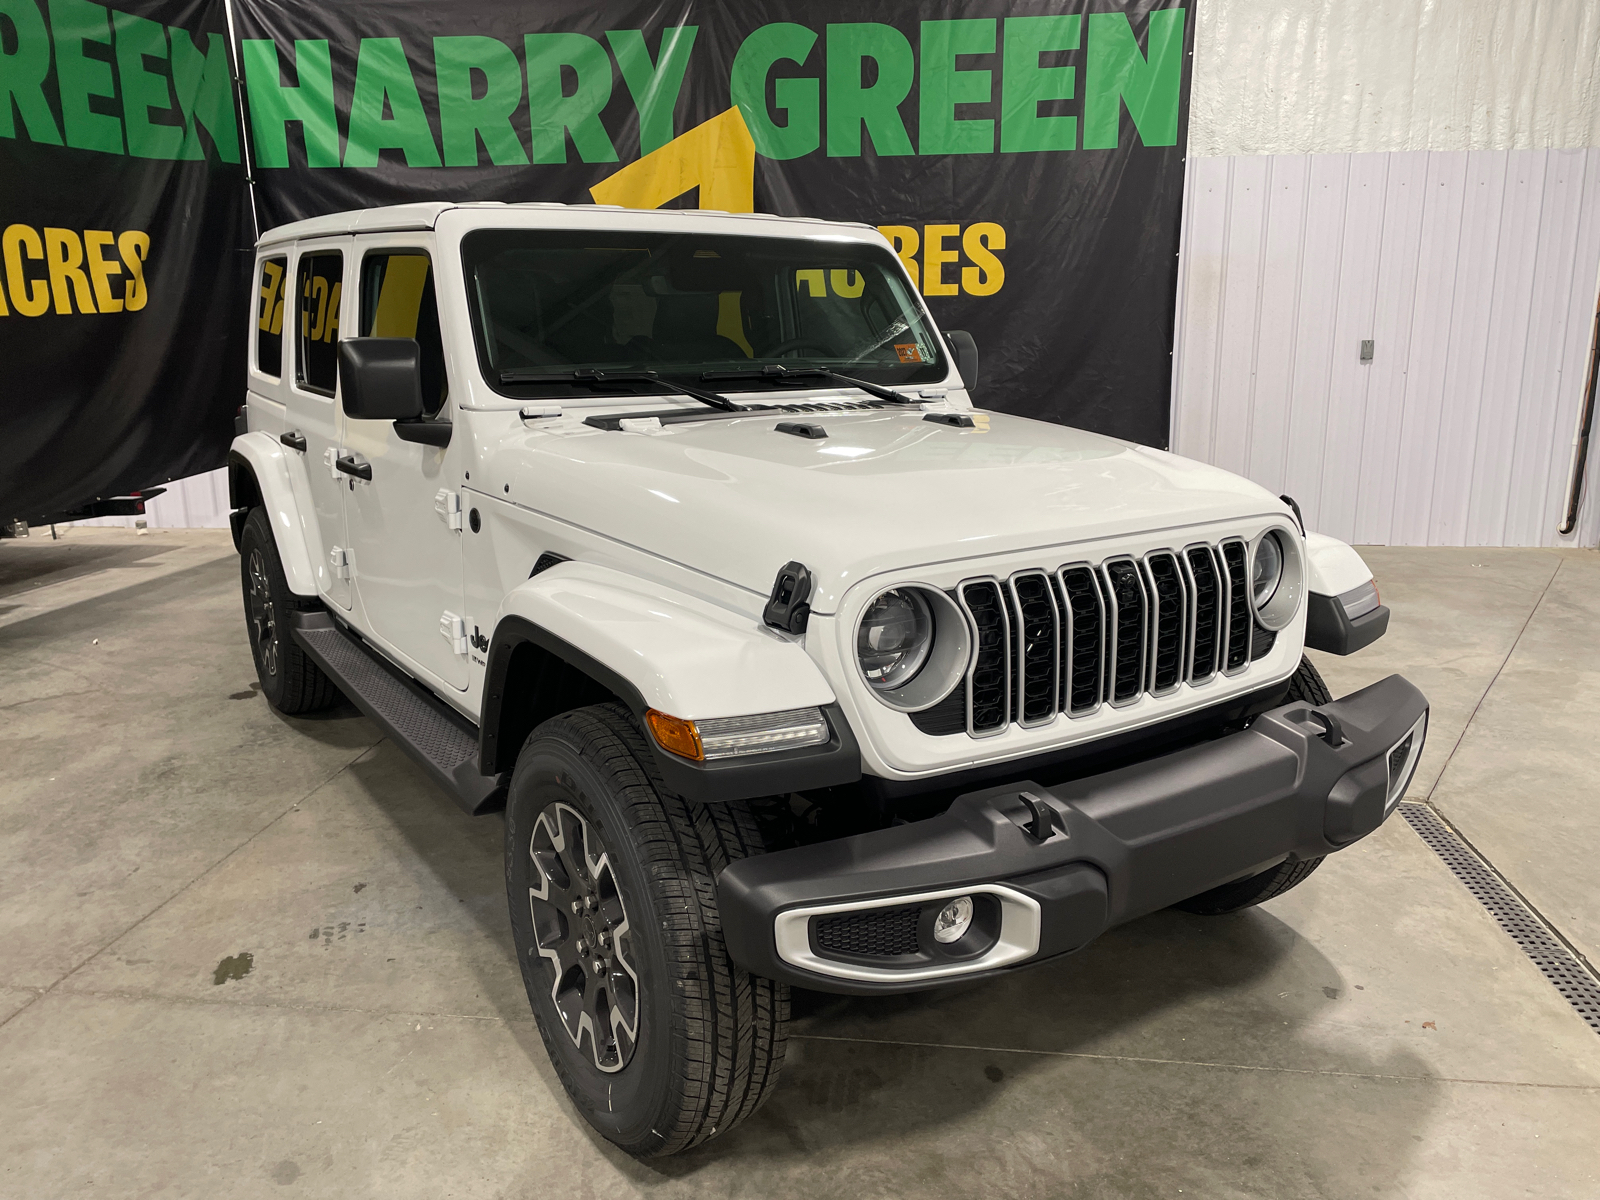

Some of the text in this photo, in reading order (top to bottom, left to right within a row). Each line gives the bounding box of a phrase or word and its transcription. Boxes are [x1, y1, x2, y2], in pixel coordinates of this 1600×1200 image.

[242, 8, 1186, 168] HARRY GREEN
[0, 223, 150, 317] CRES
[470, 625, 489, 653] Je
